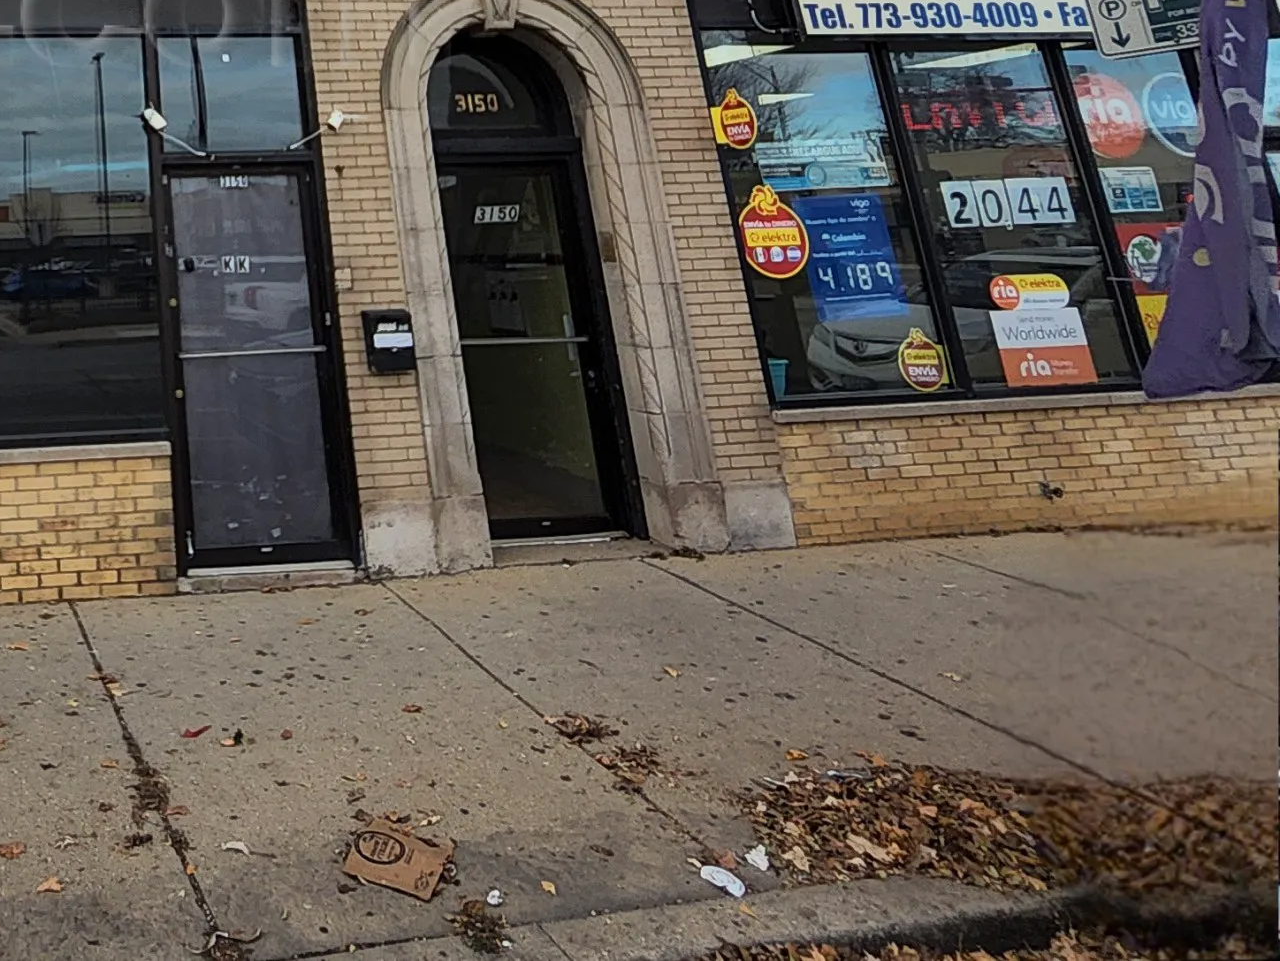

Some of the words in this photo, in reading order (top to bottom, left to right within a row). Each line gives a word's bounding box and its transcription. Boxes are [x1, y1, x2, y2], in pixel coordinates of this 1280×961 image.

[804, 3, 854, 29] Tel.
[855, 2, 1038, 29] 773-930-4009
[1057, 2, 1090, 27] Fa
[1175, 22, 1200, 38] 33
[454, 93, 499, 114] 3150
[1076, 85, 1132, 125] ria
[476, 206, 519, 222] 3150
[761, 232, 797, 243] elektra
[992, 279, 1018, 298] ria
[1029, 278, 1062, 289] elektra
[1001, 323, 1078, 342] Worldwide
[1020, 352, 1052, 377] ria
